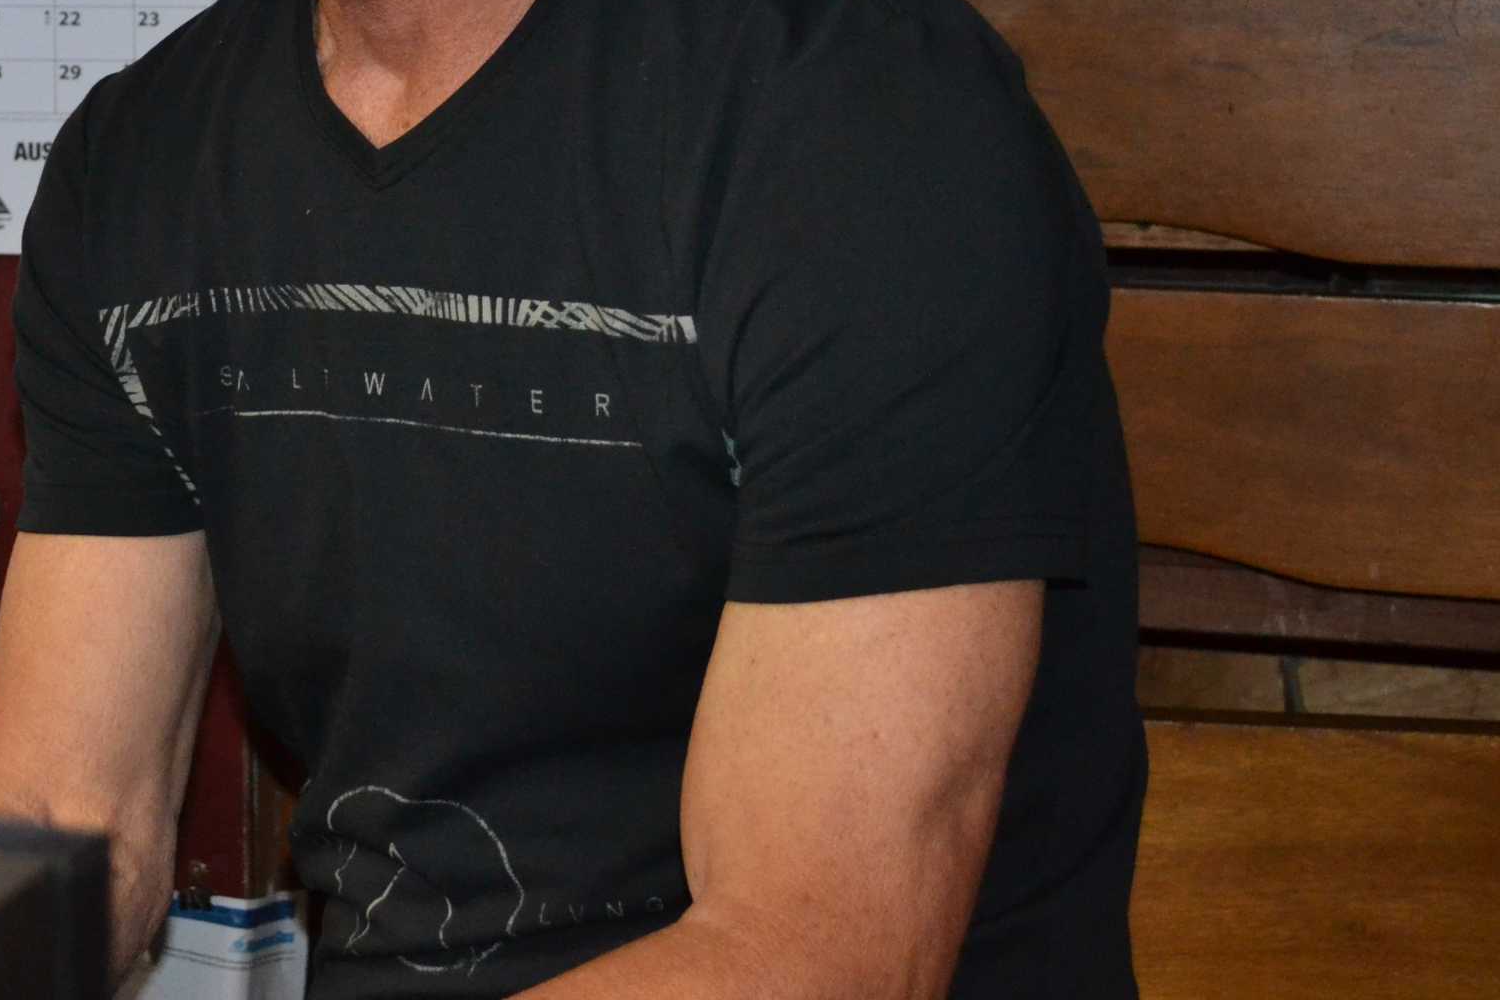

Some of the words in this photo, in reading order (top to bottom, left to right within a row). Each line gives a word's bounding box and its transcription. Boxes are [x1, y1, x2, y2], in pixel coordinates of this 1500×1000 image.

[58, 11, 81, 26] 22
[137, 11, 160, 26] 23
[59, 65, 82, 80] 29
